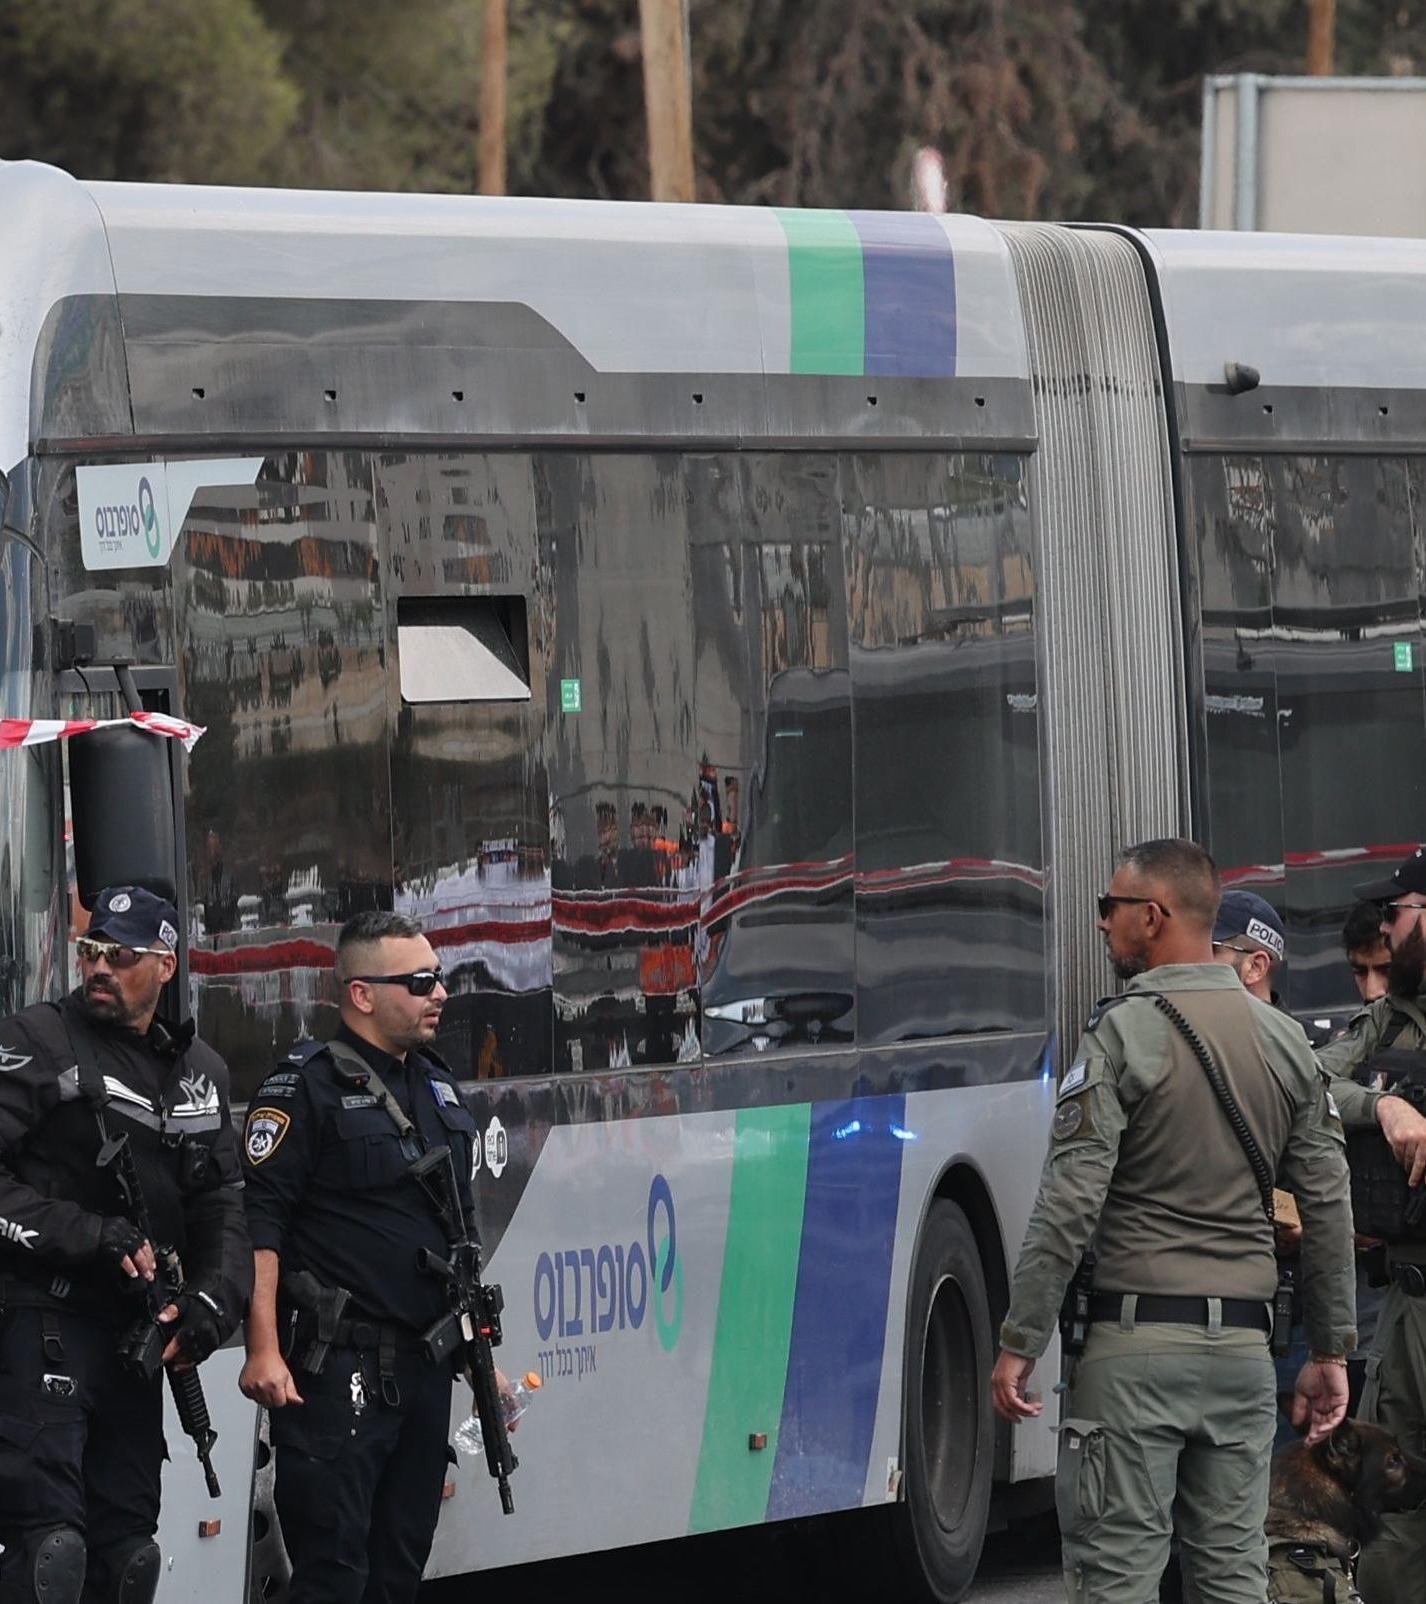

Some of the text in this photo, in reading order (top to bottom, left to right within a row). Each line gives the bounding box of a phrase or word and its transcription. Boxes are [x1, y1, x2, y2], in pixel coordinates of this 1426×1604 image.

[95, 504, 140, 538] סופרבוס
[1250, 923, 1283, 952] POLIC
[533, 1240, 647, 1341] סופרבוס
[537, 1343, 596, 1386] איתך בכל דרך
